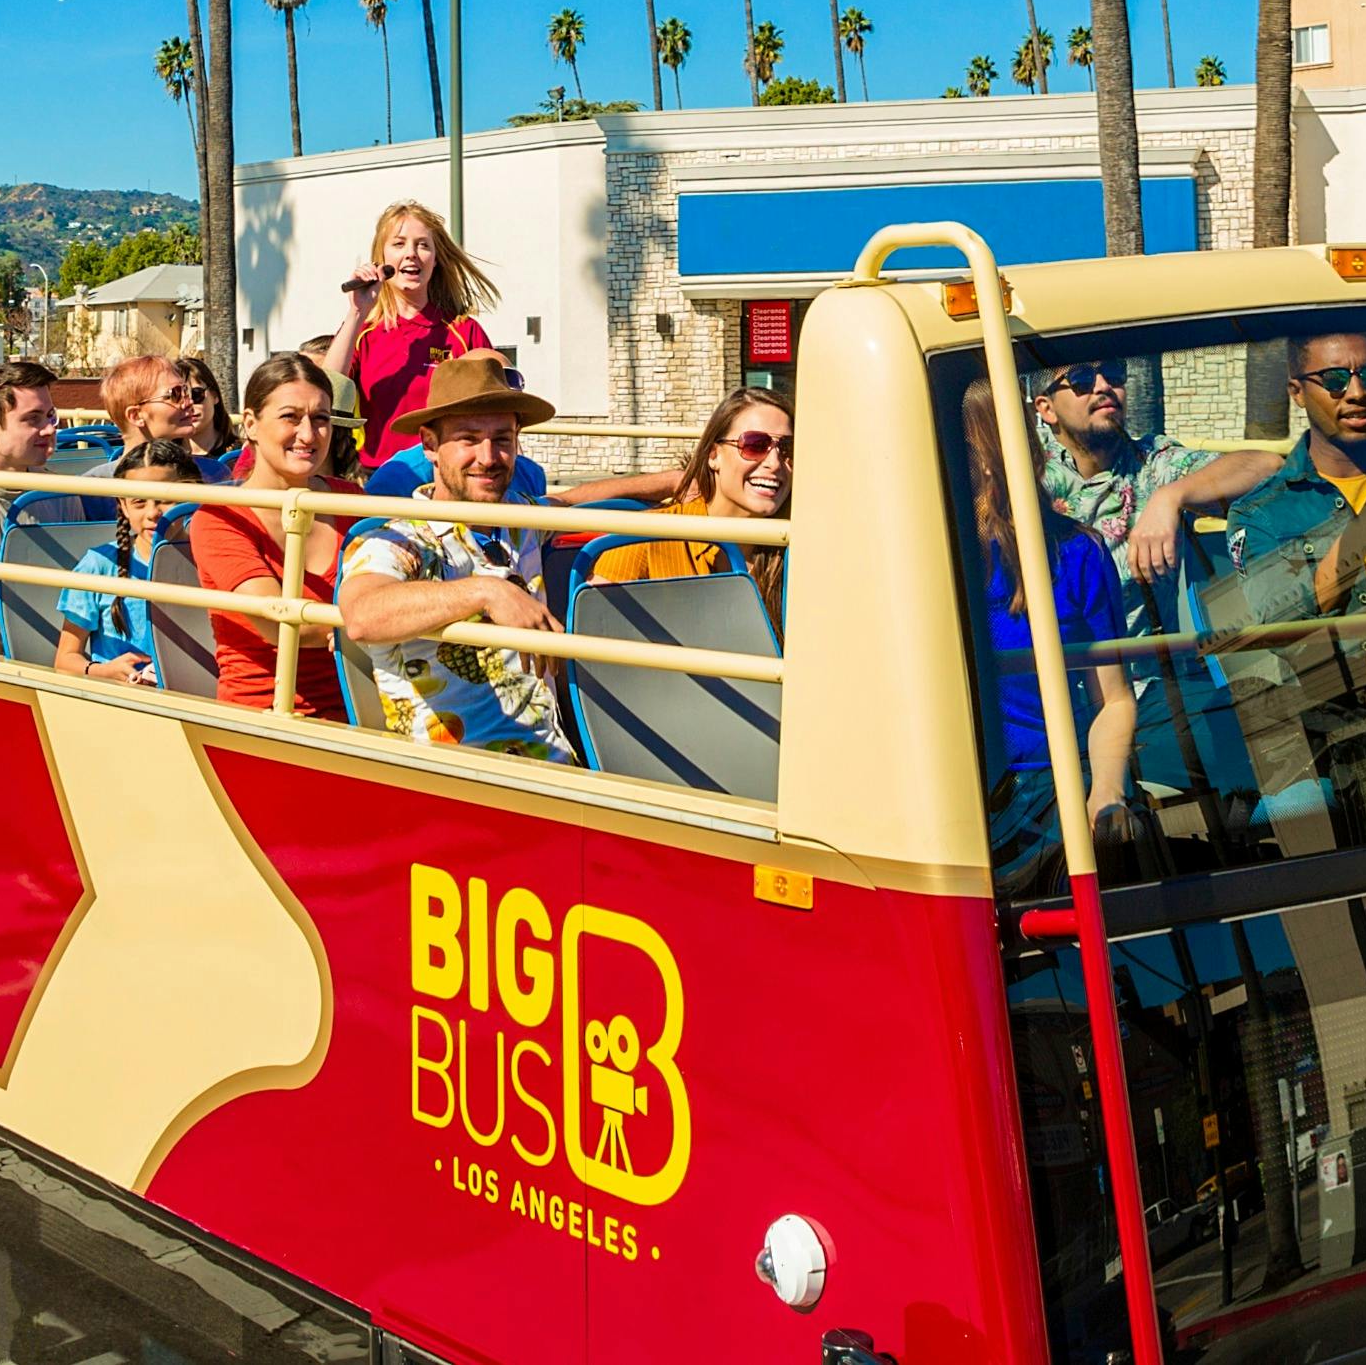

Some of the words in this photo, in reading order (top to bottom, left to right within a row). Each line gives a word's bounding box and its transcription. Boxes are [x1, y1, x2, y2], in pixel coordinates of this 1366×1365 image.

[410, 862, 555, 1028] BIG
[411, 1004, 557, 1167] BUS
[452, 1156, 500, 1204] LOS
[510, 1179, 639, 1262] ANGELES
